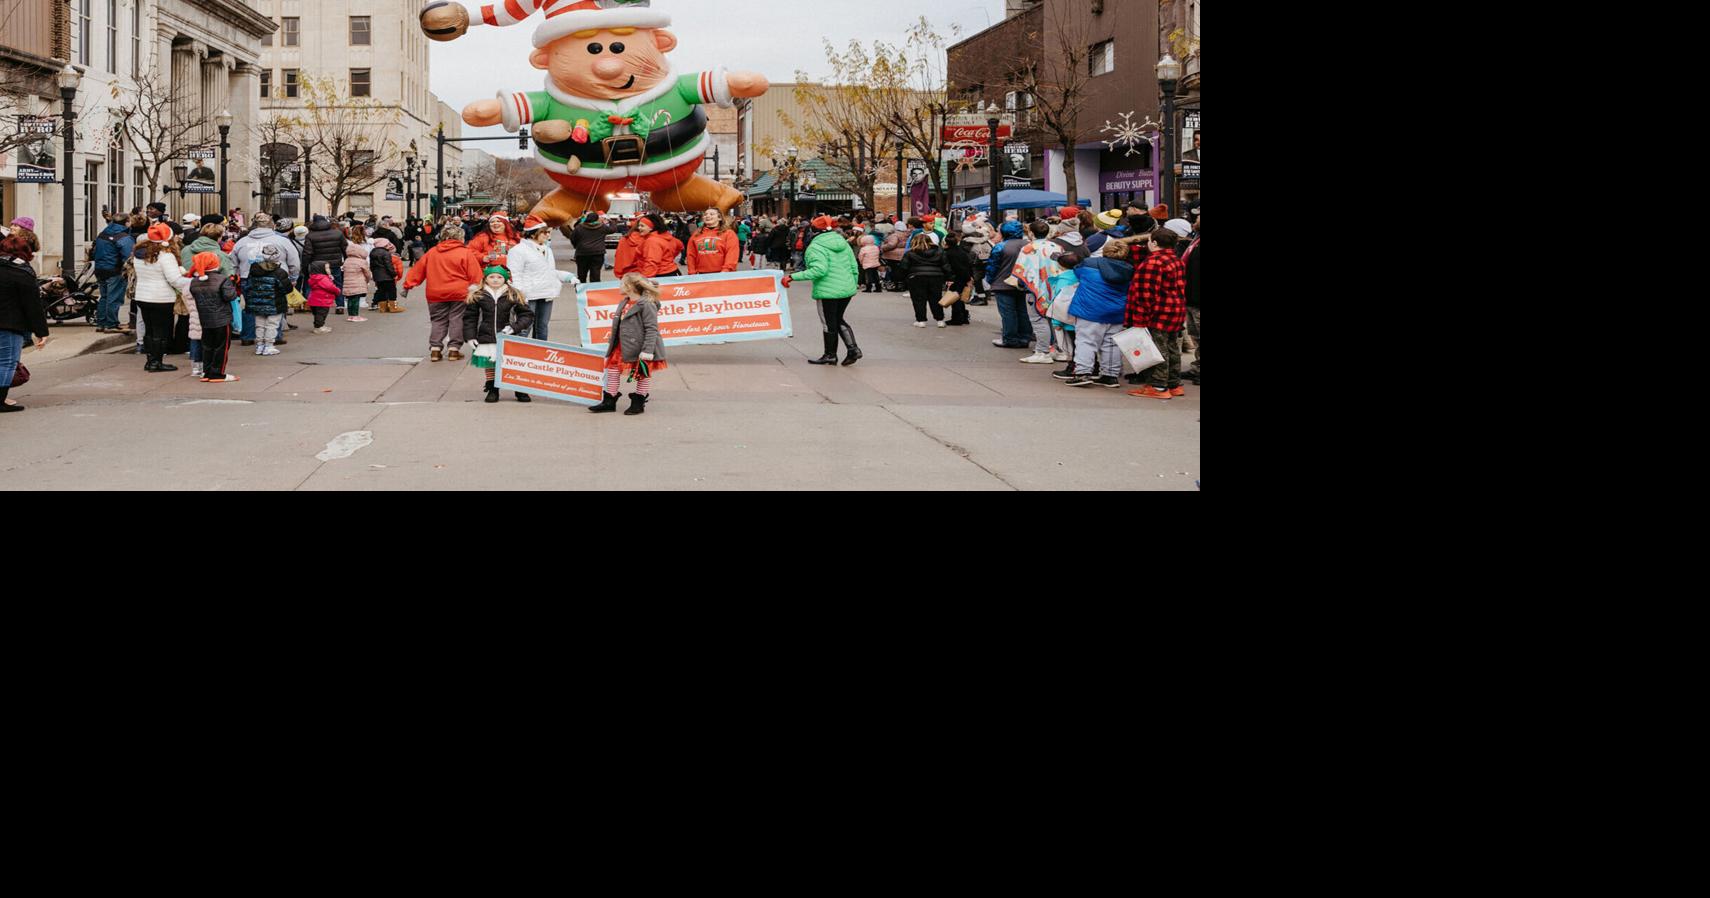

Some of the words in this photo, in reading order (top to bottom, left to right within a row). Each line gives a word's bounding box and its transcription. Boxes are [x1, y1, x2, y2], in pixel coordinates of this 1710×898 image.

[953, 127, 991, 138] Coca-Col
[1105, 181, 1130, 190] BEAUTY
[1131, 179, 1154, 189] SUPPL
[673, 286, 692, 297] The
[595, 309, 616, 320] Ne
[656, 304, 684, 316] stle
[688, 299, 771, 315] Playhouse
[672, 325, 700, 334] comfort
[702, 323, 713, 332] of
[712, 324, 730, 333] your
[732, 321, 769, 330] Hometown
[543, 349, 565, 364] The
[505, 358, 526, 368] New
[527, 361, 554, 372] Castle
[555, 366, 600, 382] Playhouse
